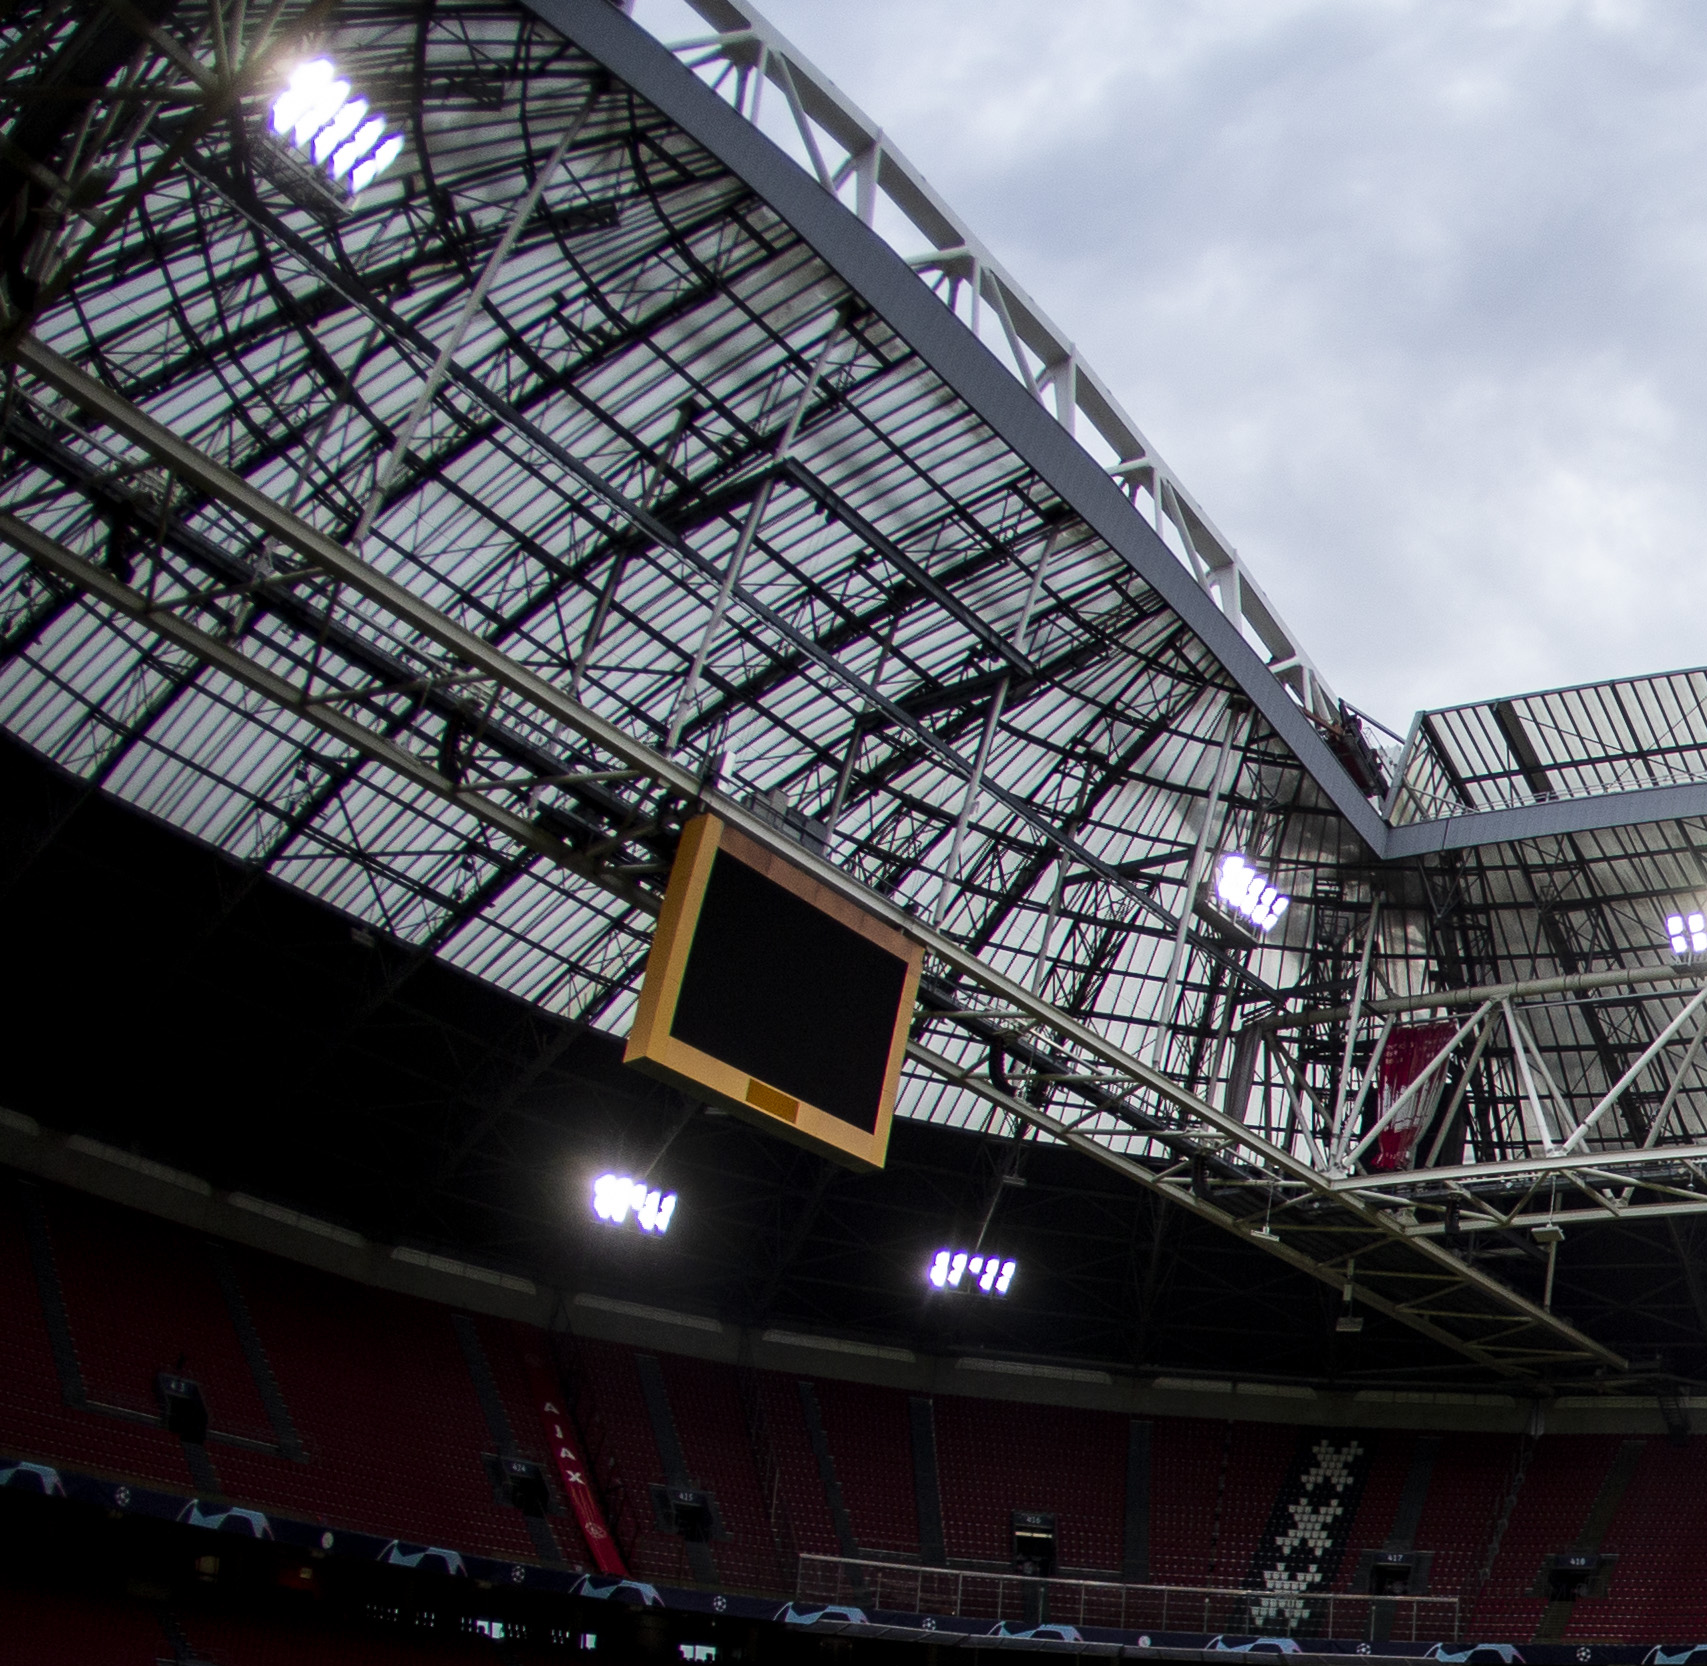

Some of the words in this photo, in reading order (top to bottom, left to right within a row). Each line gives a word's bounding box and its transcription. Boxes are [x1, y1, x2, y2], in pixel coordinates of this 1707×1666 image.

[169, 1381, 186, 1393] 43
[544, 1402, 586, 1485] AJAX
[679, 1492, 693, 1502] 415
[1387, 1554, 1403, 1562] 417
